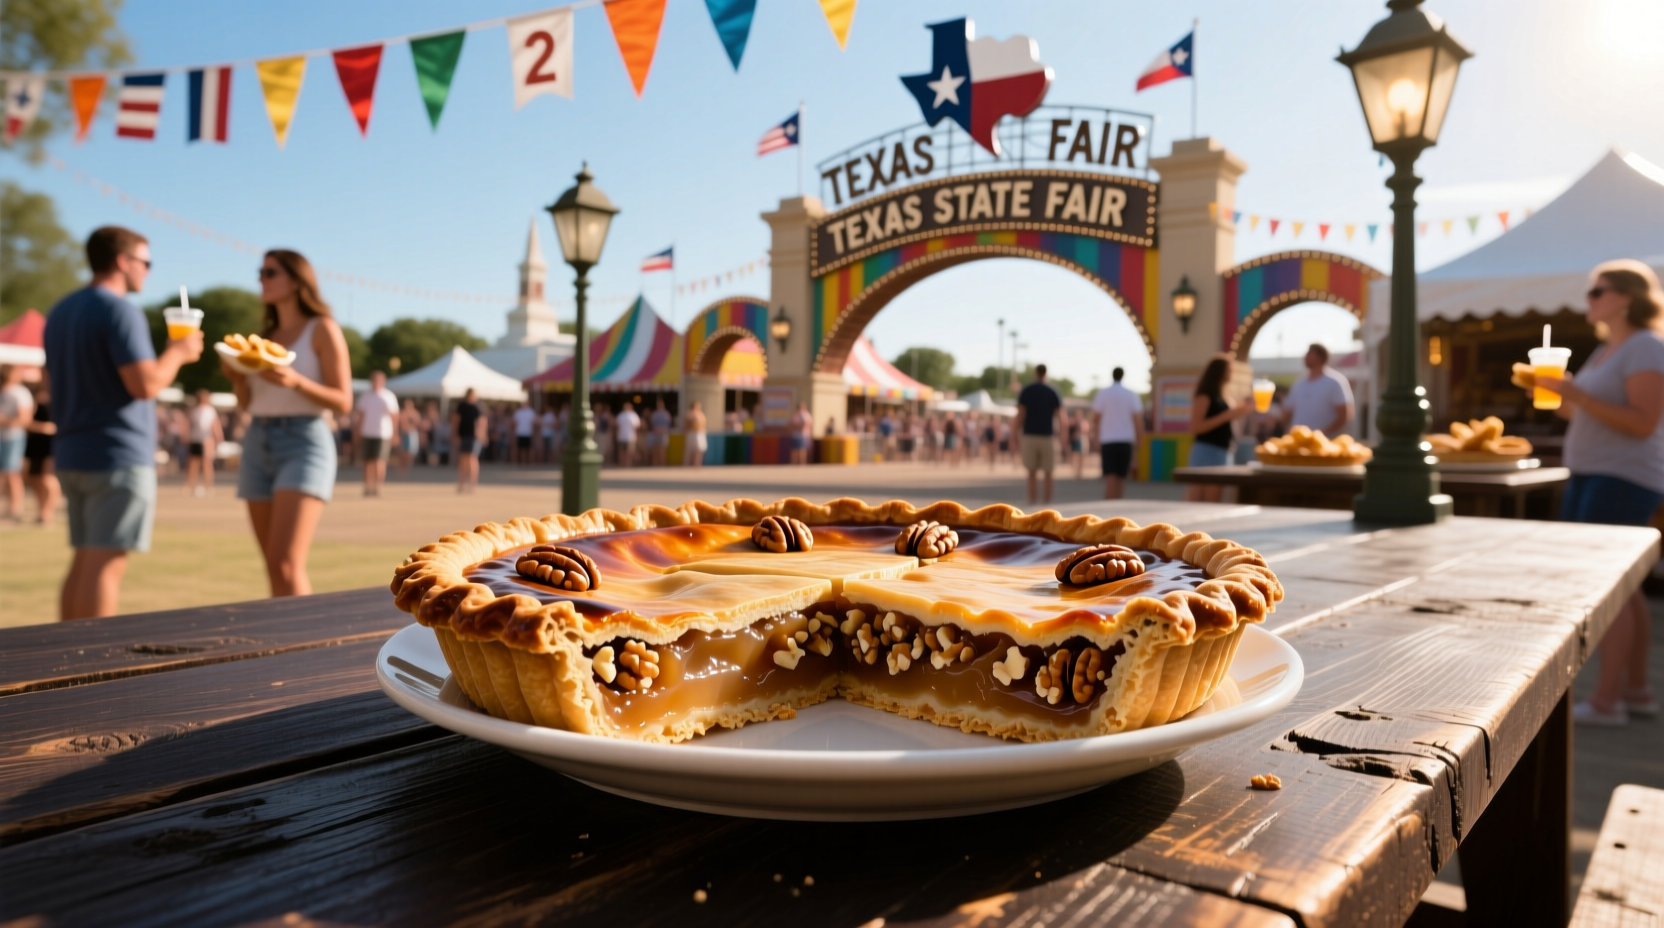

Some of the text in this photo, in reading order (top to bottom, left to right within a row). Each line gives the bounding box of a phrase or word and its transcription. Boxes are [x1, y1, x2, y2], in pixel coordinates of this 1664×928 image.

[525, 31, 556, 85] 2
[822, 119, 1139, 204] TEXAS FAIR
[828, 181, 1127, 253] TEXAS STATE FAIR
